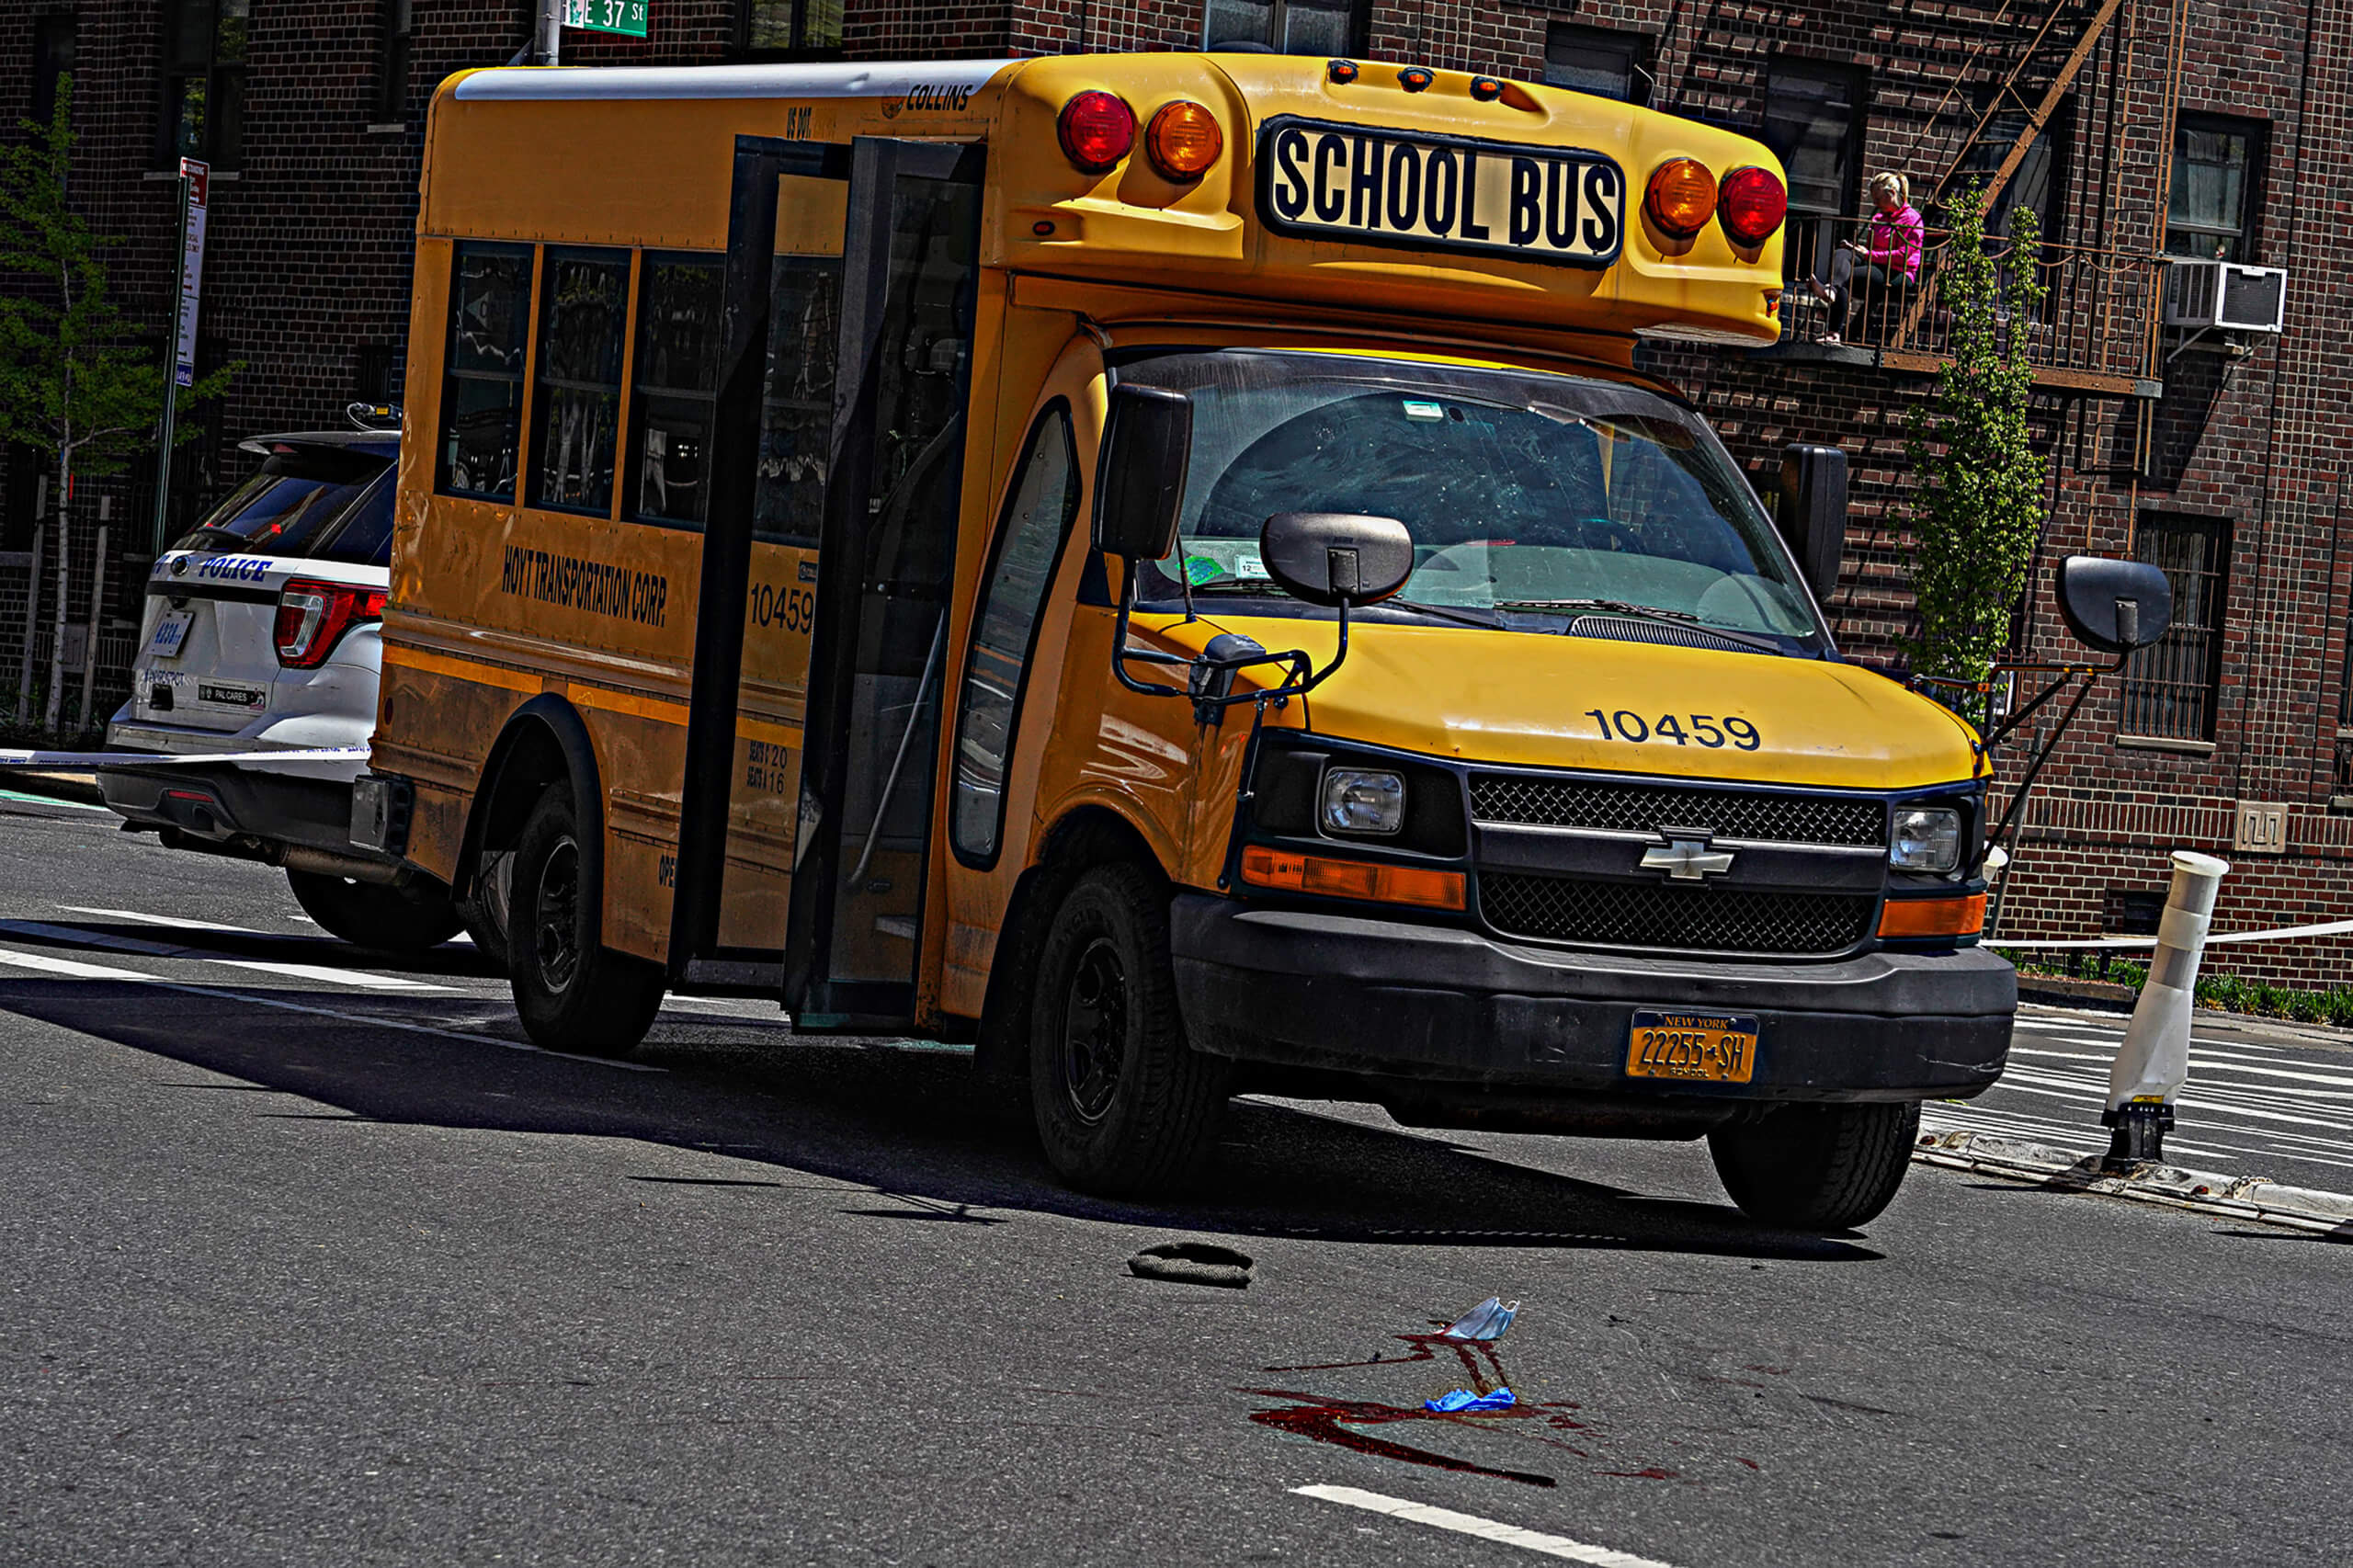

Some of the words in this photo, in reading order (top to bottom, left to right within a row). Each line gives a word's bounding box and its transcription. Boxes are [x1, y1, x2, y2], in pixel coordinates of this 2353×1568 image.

[585, 0, 594, 24] E
[603, 1, 625, 28] 37
[631, 3, 643, 21] St
[906, 85, 973, 111] COLLINS
[1275, 128, 1490, 241] SCHOOL
[1509, 155, 1616, 254] BUS
[199, 557, 274, 582] POLICE
[502, 544, 534, 597] HOYT
[534, 551, 631, 619] TRANSPORTATION
[632, 571, 667, 628] CORP.
[751, 583, 814, 635] 10459
[215, 689, 227, 699] PAL
[227, 691, 248, 702] CARES
[1584, 709, 1761, 752] 10459
[771, 744, 788, 769] 20
[770, 771, 785, 795] 16
[1665, 1015, 1696, 1027] NEW
[1697, 1017, 1729, 1029] YORK
[1641, 1029, 1707, 1066] 22255
[1717, 1034, 1746, 1070] SH
[1669, 1067, 1711, 1078] SCHOOL
